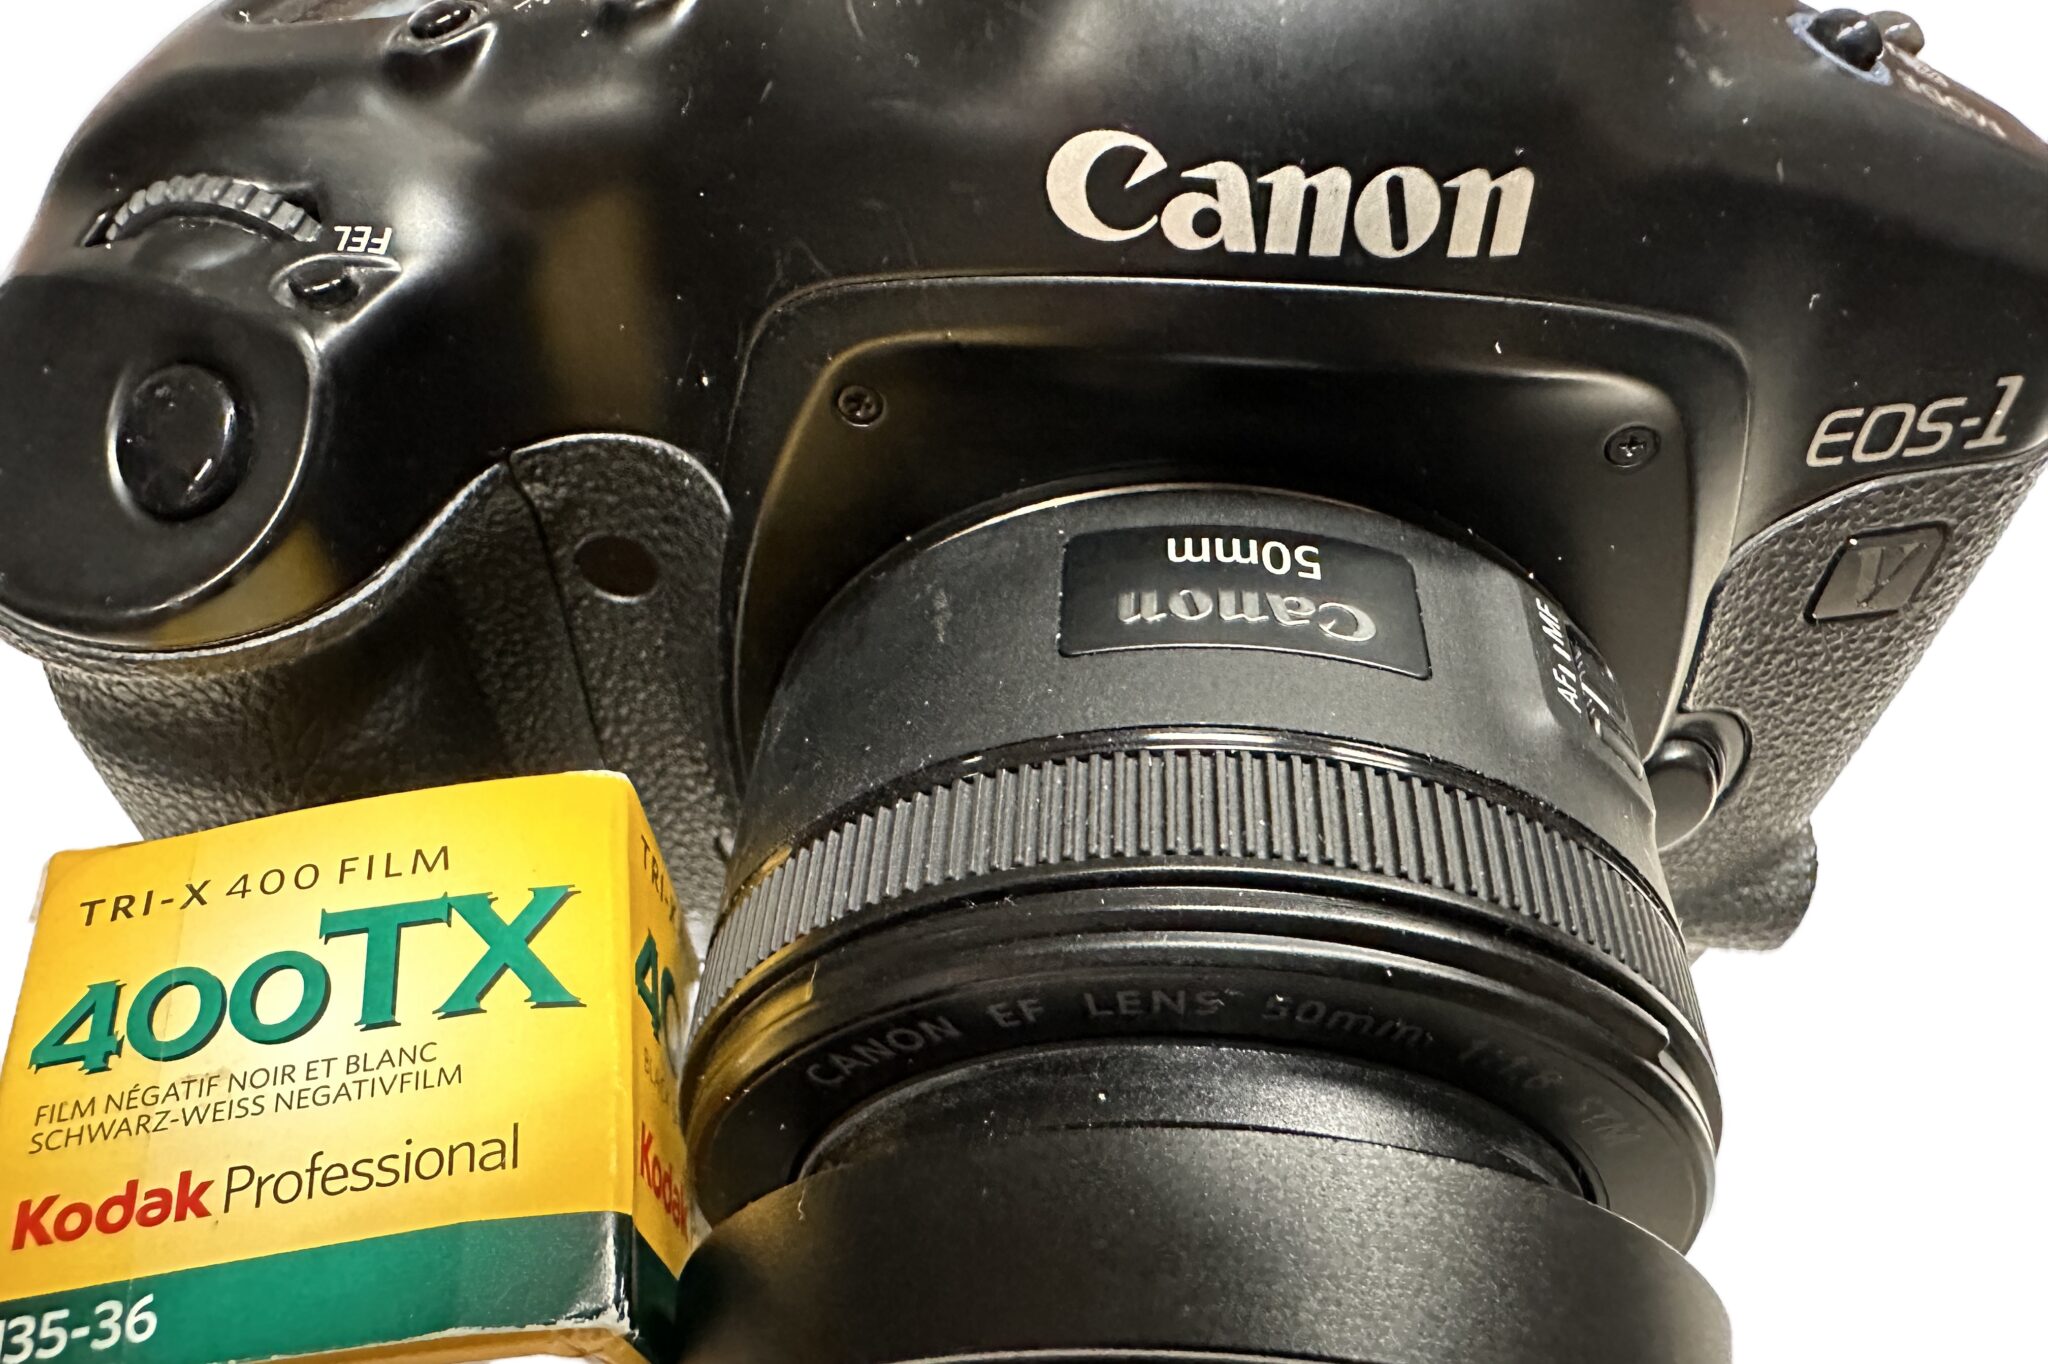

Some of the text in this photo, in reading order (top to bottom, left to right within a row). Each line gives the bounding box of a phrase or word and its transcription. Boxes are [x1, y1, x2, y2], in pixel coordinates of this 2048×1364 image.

[1046, 129, 1535, 259] Canon
[333, 226, 393, 255] FEL
[1806, 375, 2025, 468] EOS-1
[1166, 536, 1322, 580] 50mm
[1117, 588, 1377, 643] Canon
[80, 845, 451, 927] TRI-X 400 FILM
[28, 884, 587, 1075] 400TX
[806, 1015, 962, 1087] CANON
[987, 998, 1044, 1028] EF
[1087, 988, 1226, 1019] LENS
[28, 1064, 464, 1155] SCHWARZ-WEISS NEGATIVFILM
[34, 1041, 439, 1128] FILM NÉGATIF NOIR ET BLANC
[11, 1122, 520, 1251] Kodak Professional
